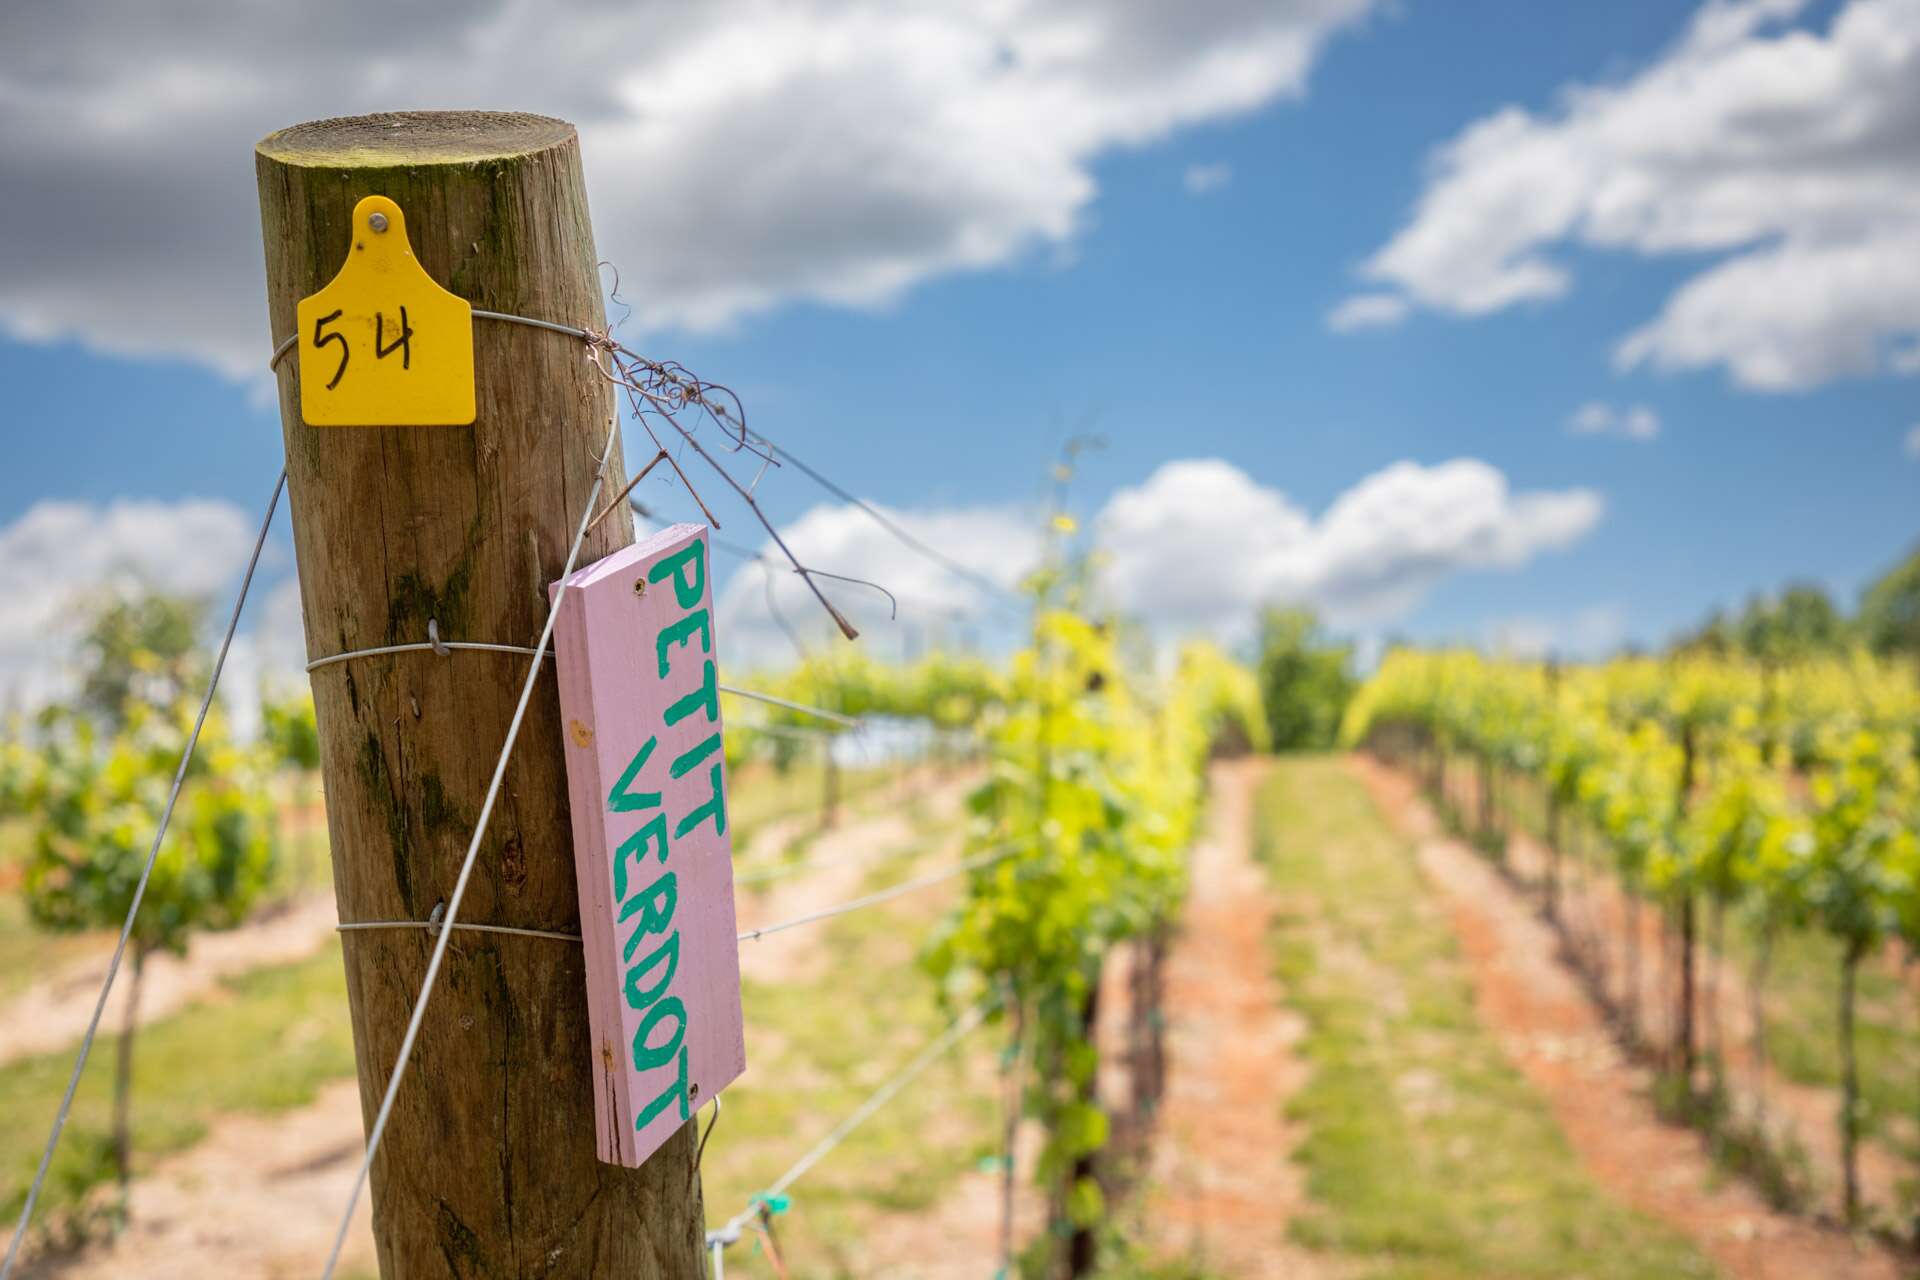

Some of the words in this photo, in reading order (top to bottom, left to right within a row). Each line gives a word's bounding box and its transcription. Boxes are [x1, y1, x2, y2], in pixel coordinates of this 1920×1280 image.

[312, 305, 415, 391] 54
[648, 537, 726, 839] PETIT
[607, 735, 690, 1132] VERDOT
